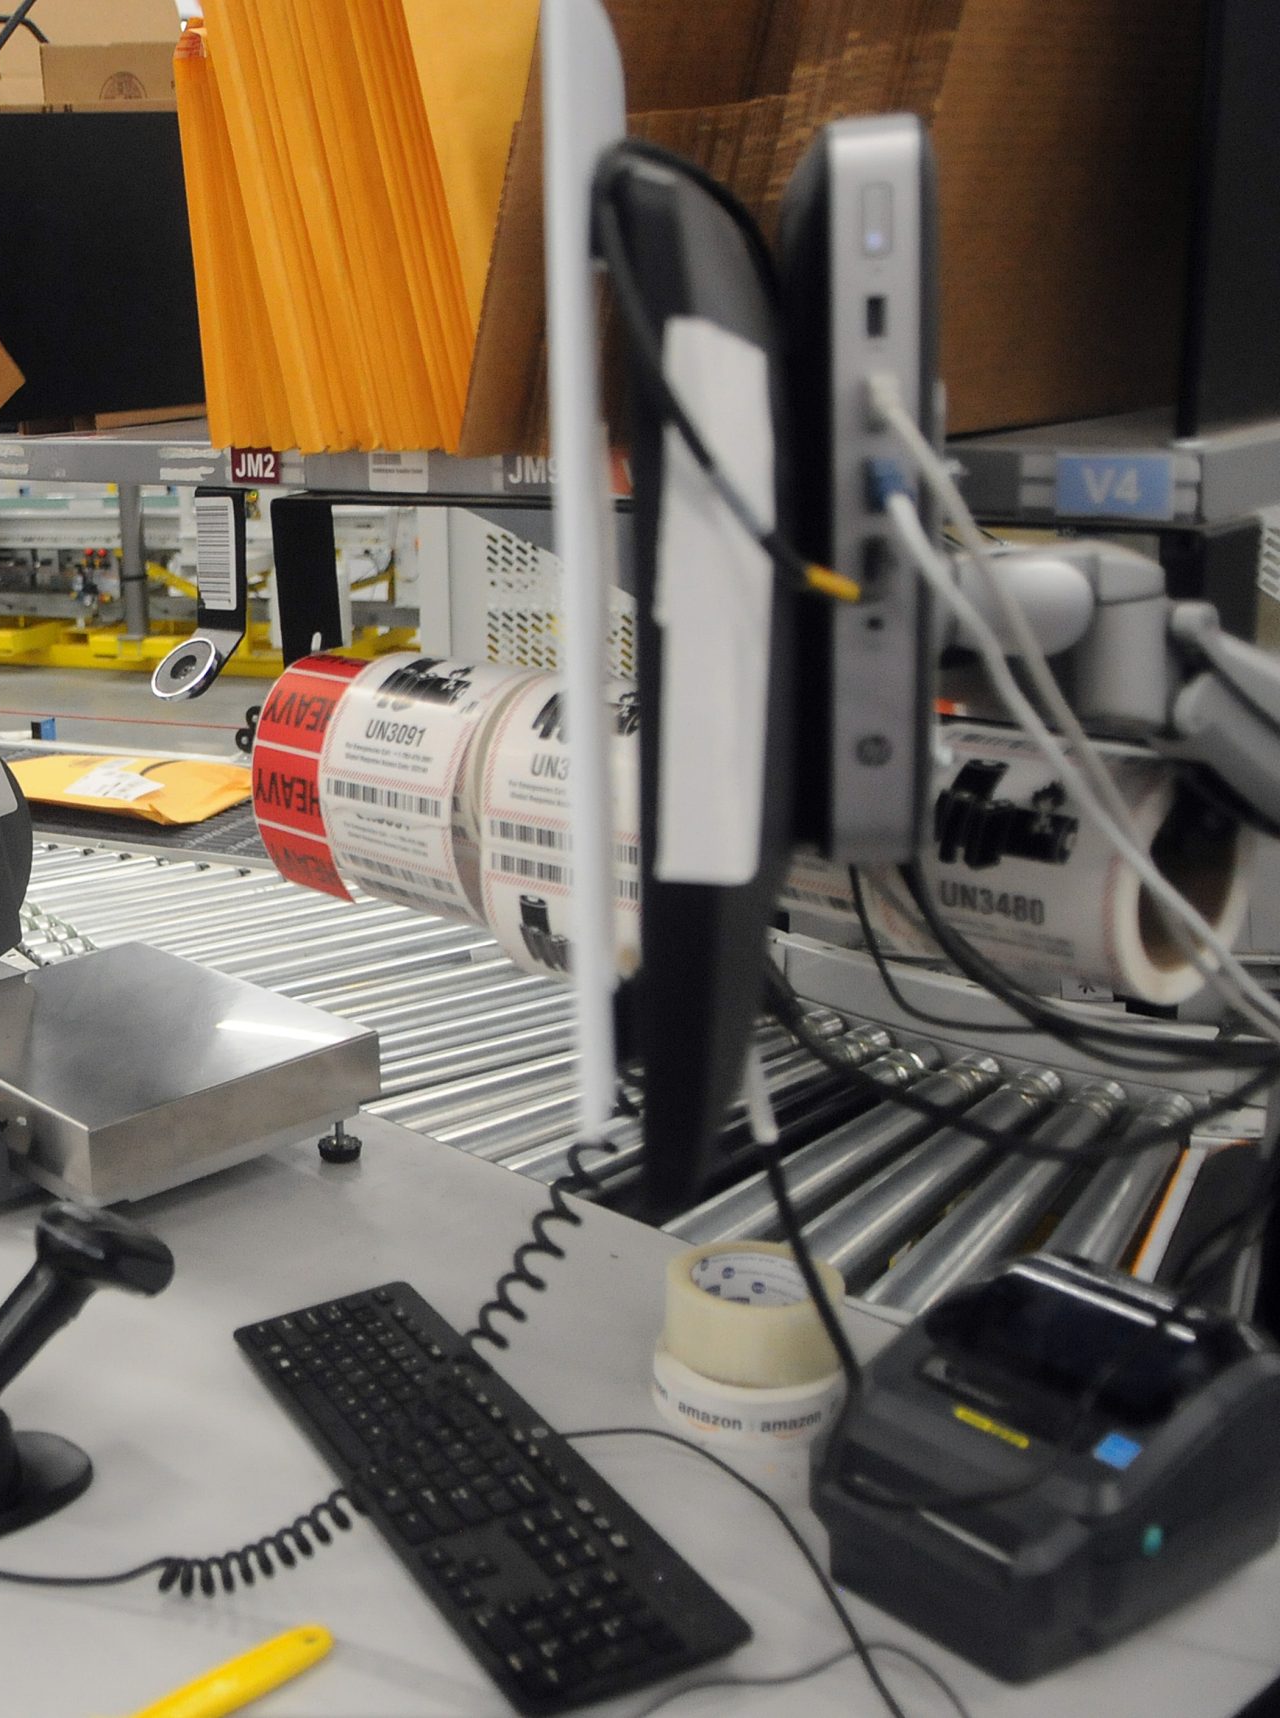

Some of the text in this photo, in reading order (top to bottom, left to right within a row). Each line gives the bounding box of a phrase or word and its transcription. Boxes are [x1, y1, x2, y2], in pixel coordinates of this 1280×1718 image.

[234, 452, 277, 479] JM2
[1081, 463, 1142, 505] V4
[364, 718, 427, 749] UN3091
[255, 767, 323, 818] HEAVY
[939, 879, 1046, 926] UN3480
[677, 1401, 823, 1434] amazon amazon
